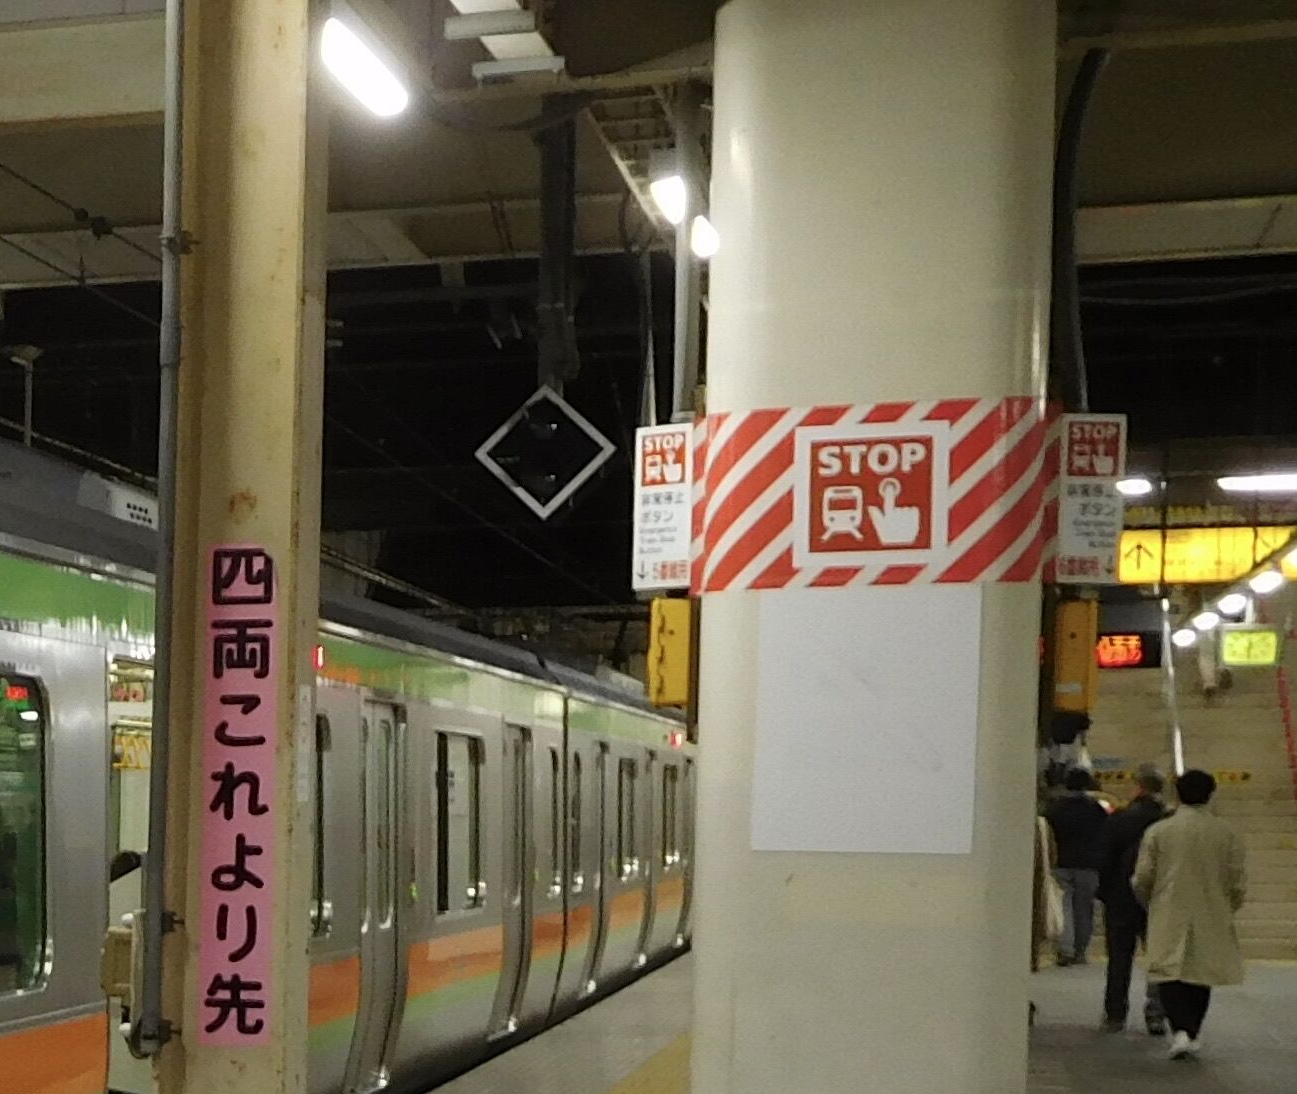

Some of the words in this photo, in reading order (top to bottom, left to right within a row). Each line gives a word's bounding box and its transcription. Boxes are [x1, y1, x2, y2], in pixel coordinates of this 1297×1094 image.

[644, 434, 684, 450] STOP
[1071, 424, 1118, 440] STOP
[817, 442, 927, 477] STOP
[204, 547, 274, 1036] 四両これより先
